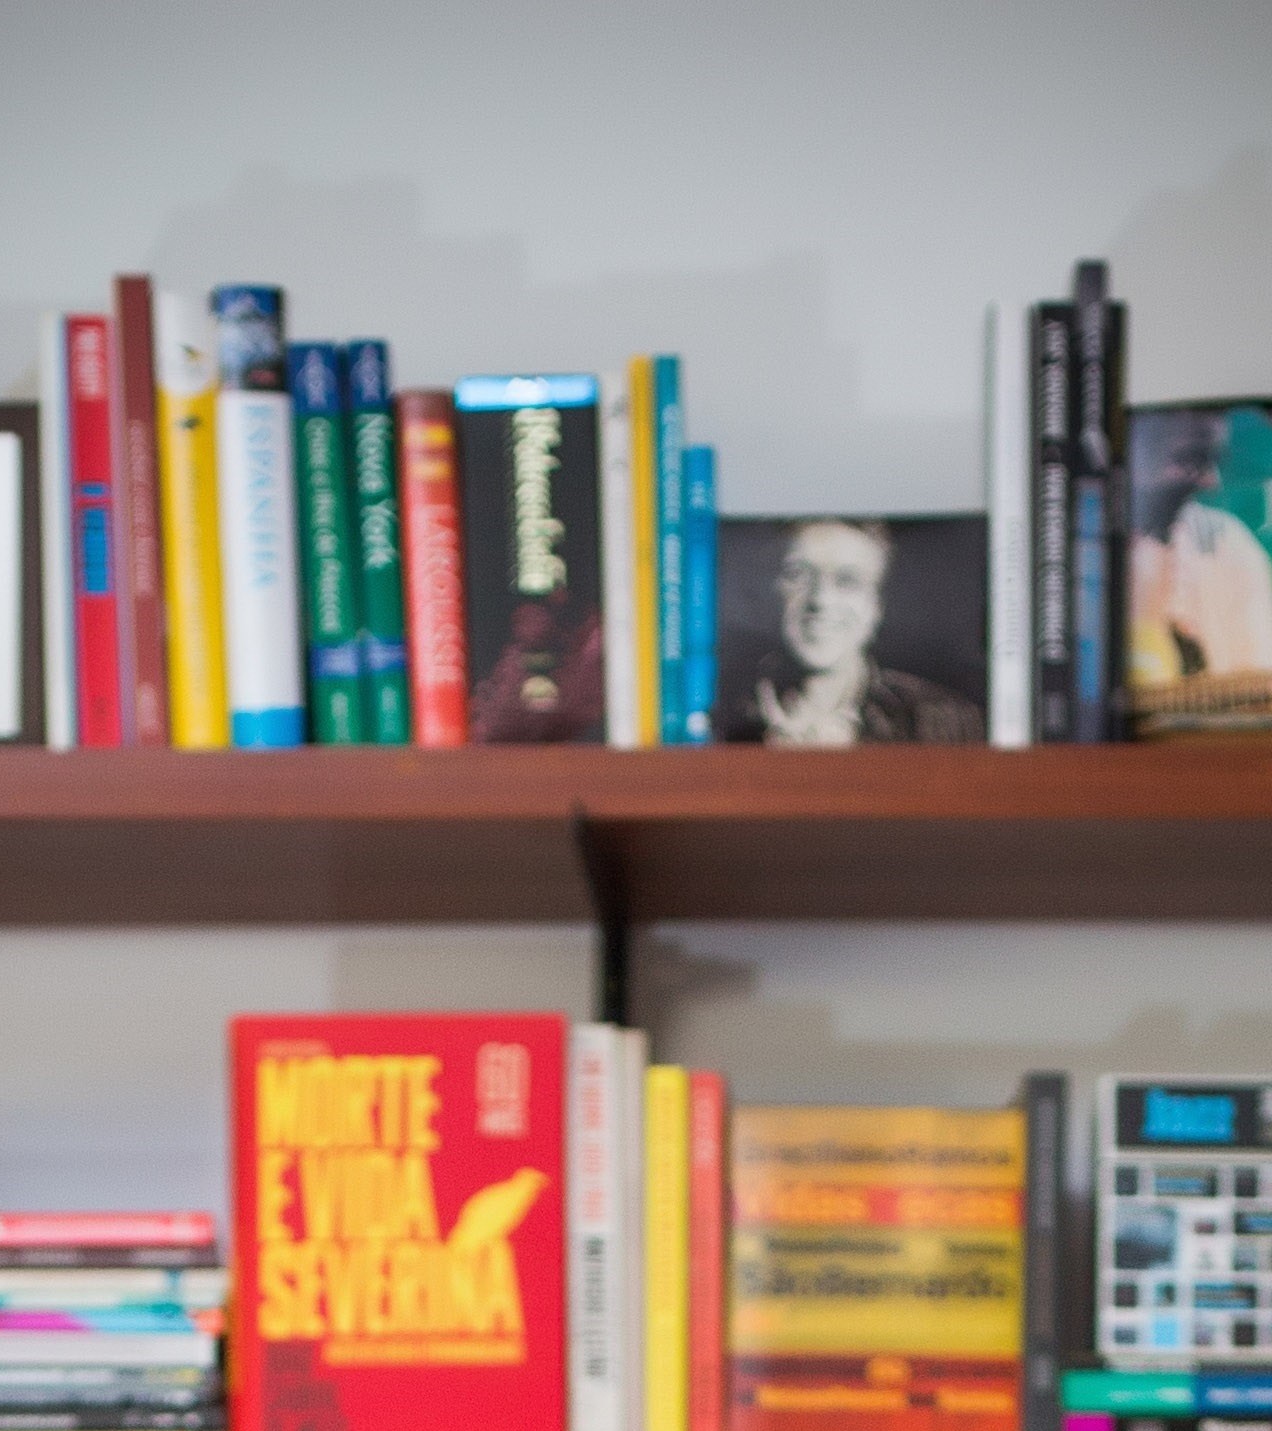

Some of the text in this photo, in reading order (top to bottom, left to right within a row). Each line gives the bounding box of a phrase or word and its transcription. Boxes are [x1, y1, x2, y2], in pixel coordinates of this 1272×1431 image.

[355, 412, 398, 569] Nova York
[256, 1054, 443, 1149] MORTE
